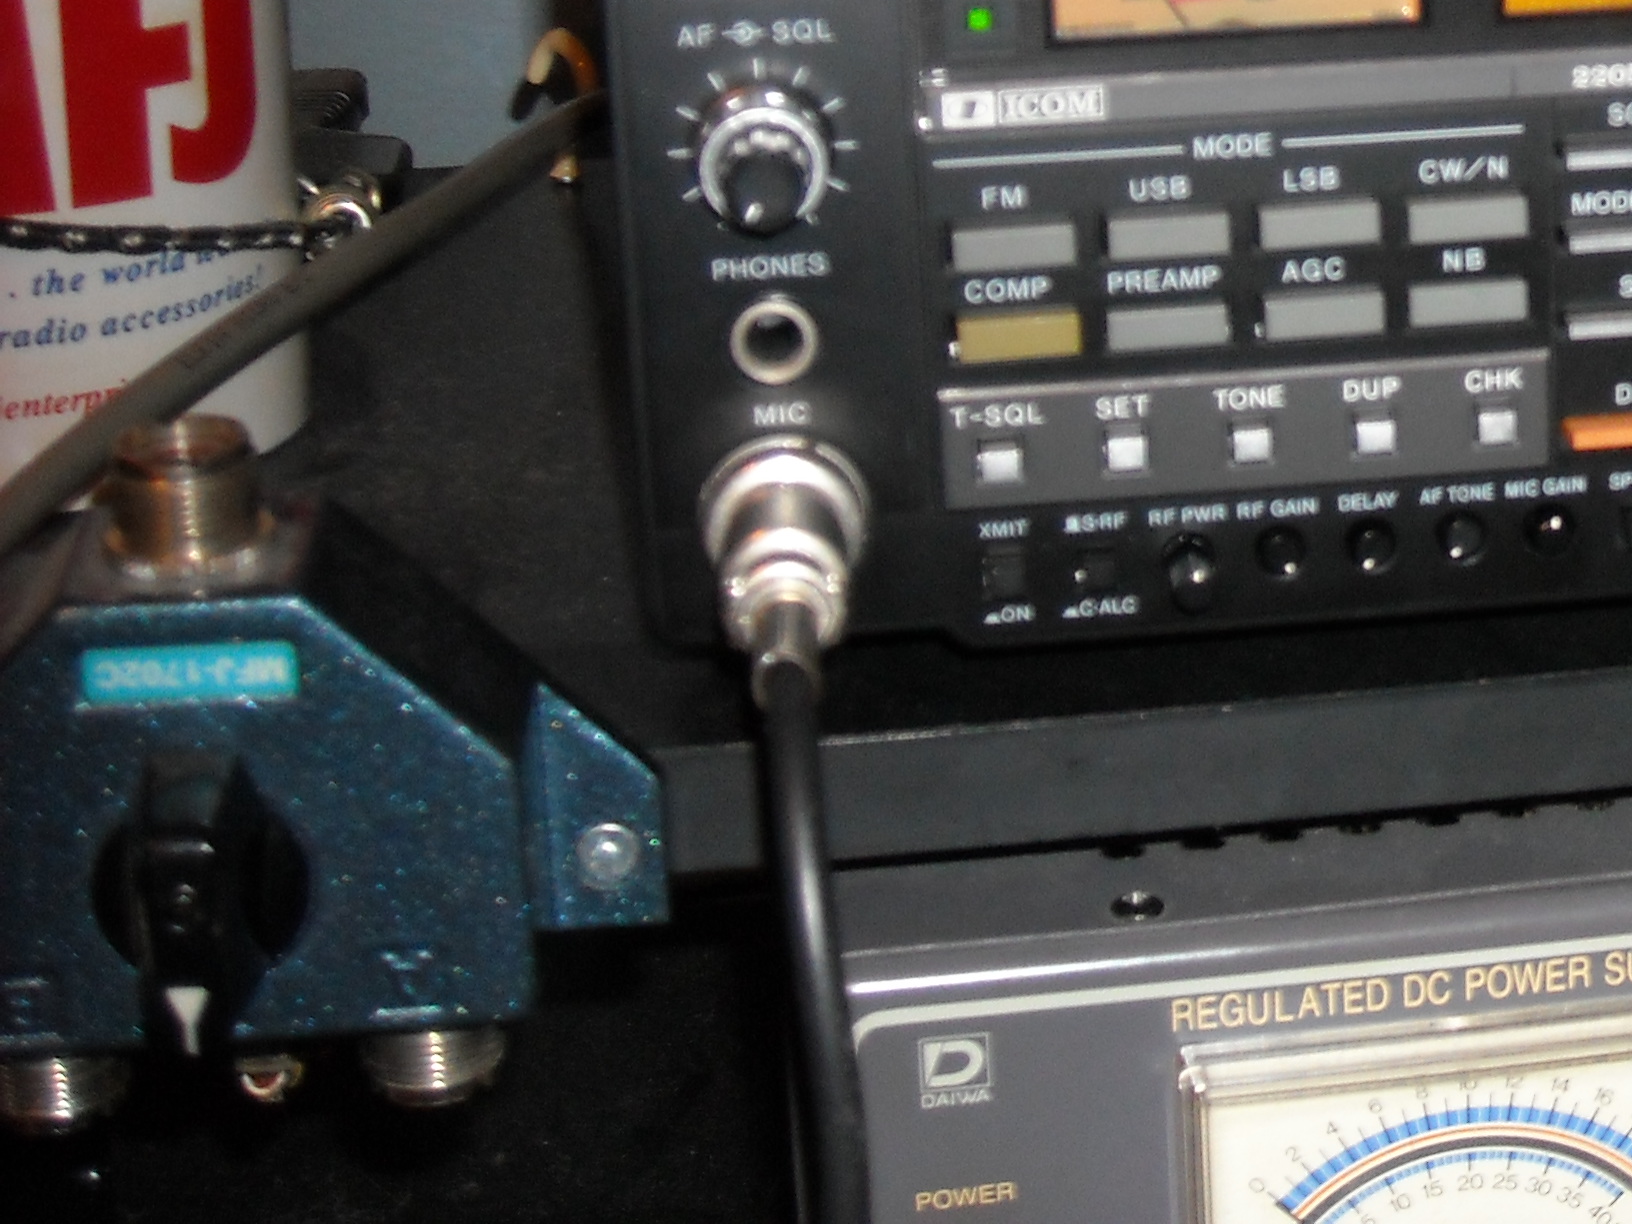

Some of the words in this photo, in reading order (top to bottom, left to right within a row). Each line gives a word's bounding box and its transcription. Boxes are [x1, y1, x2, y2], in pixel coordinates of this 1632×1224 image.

[677, 24, 715, 48] AF
[772, 17, 836, 46] SQL
[1003, 88, 1099, 119] ICOM
[1193, 132, 1274, 159] MODE
[1282, 166, 1341, 192] LSB
[1418, 156, 1510, 185] CW/N
[981, 185, 1027, 210] FM
[1129, 175, 1192, 202] USB
[710, 251, 831, 281] PHONES
[1281, 256, 1347, 284] AGC
[1442, 246, 1487, 273] NB
[32, 269, 86, 296] the
[963, 276, 1051, 304] COMP
[1106, 264, 1223, 294] PREAMP
[1342, 377, 1402, 402] DUP
[1464, 367, 1524, 394] CHK
[1095, 393, 1151, 420] SET
[1212, 384, 1286, 411] TONE
[753, 401, 810, 425] MIC
[950, 403, 1045, 431] T-SQL
[1418, 486, 1443, 506] AF
[1446, 482, 1496, 503] TONE
[1504, 480, 1538, 500] MIC
[1542, 476, 1588, 496] GAIN
[1148, 509, 1177, 527] RF
[1181, 502, 1229, 525] PWR
[1236, 502, 1265, 520] RF
[1270, 496, 1320, 518] GAIN
[1338, 491, 1399, 513] DELAY
[978, 519, 1029, 539] XMIT
[1000, 605, 1036, 622] ON
[1171, 978, 1392, 1033] REGULATED
[1403, 972, 1453, 1009] DC
[1465, 955, 1592, 1003] POWER
[921, 1088, 993, 1110] DAIWA
[1285, 1145, 1303, 1163] 2
[1325, 1120, 1340, 1138] 4
[1368, 1097, 1385, 1115] 6
[1551, 1077, 1570, 1093] 14
[1593, 1087, 1615, 1106] 16
[915, 1181, 1017, 1212] POWER
[1389, 1192, 1413, 1213] 10
[1423, 1177, 1446, 1199] 15
[1457, 1173, 1485, 1192] 20
[1492, 1173, 1519, 1192] 25
[1524, 1178, 1554, 1199] 30
[1555, 1184, 1585, 1209] 35
